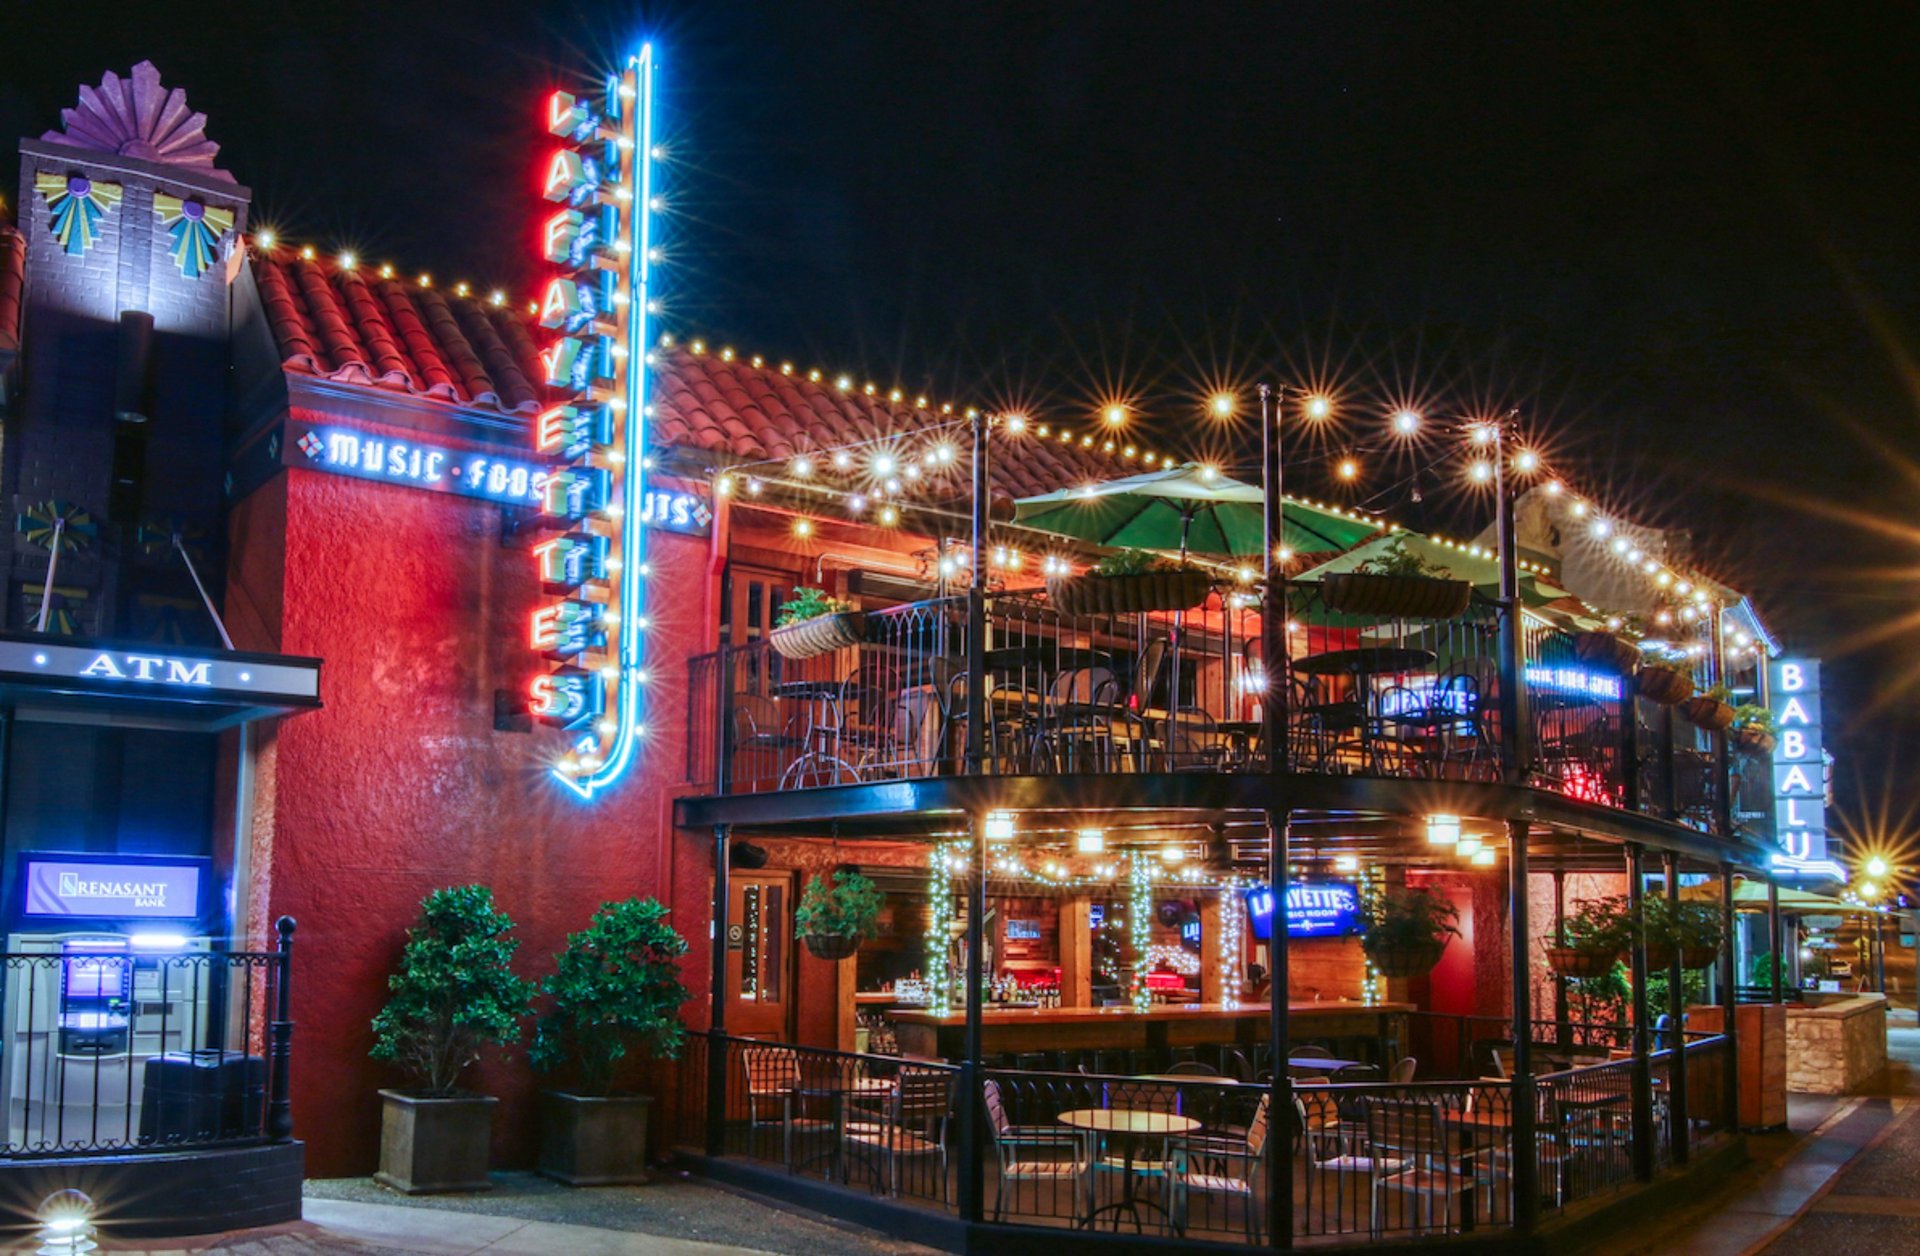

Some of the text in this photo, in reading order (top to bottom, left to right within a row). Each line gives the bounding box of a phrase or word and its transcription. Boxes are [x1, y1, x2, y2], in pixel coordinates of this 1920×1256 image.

[329, 431, 444, 483] MUSIC
[79, 653, 213, 685] ATM
[1778, 663, 1812, 861] BABALU
[77, 880, 168, 897] RENASANT
[134, 896, 167, 908] BANK
